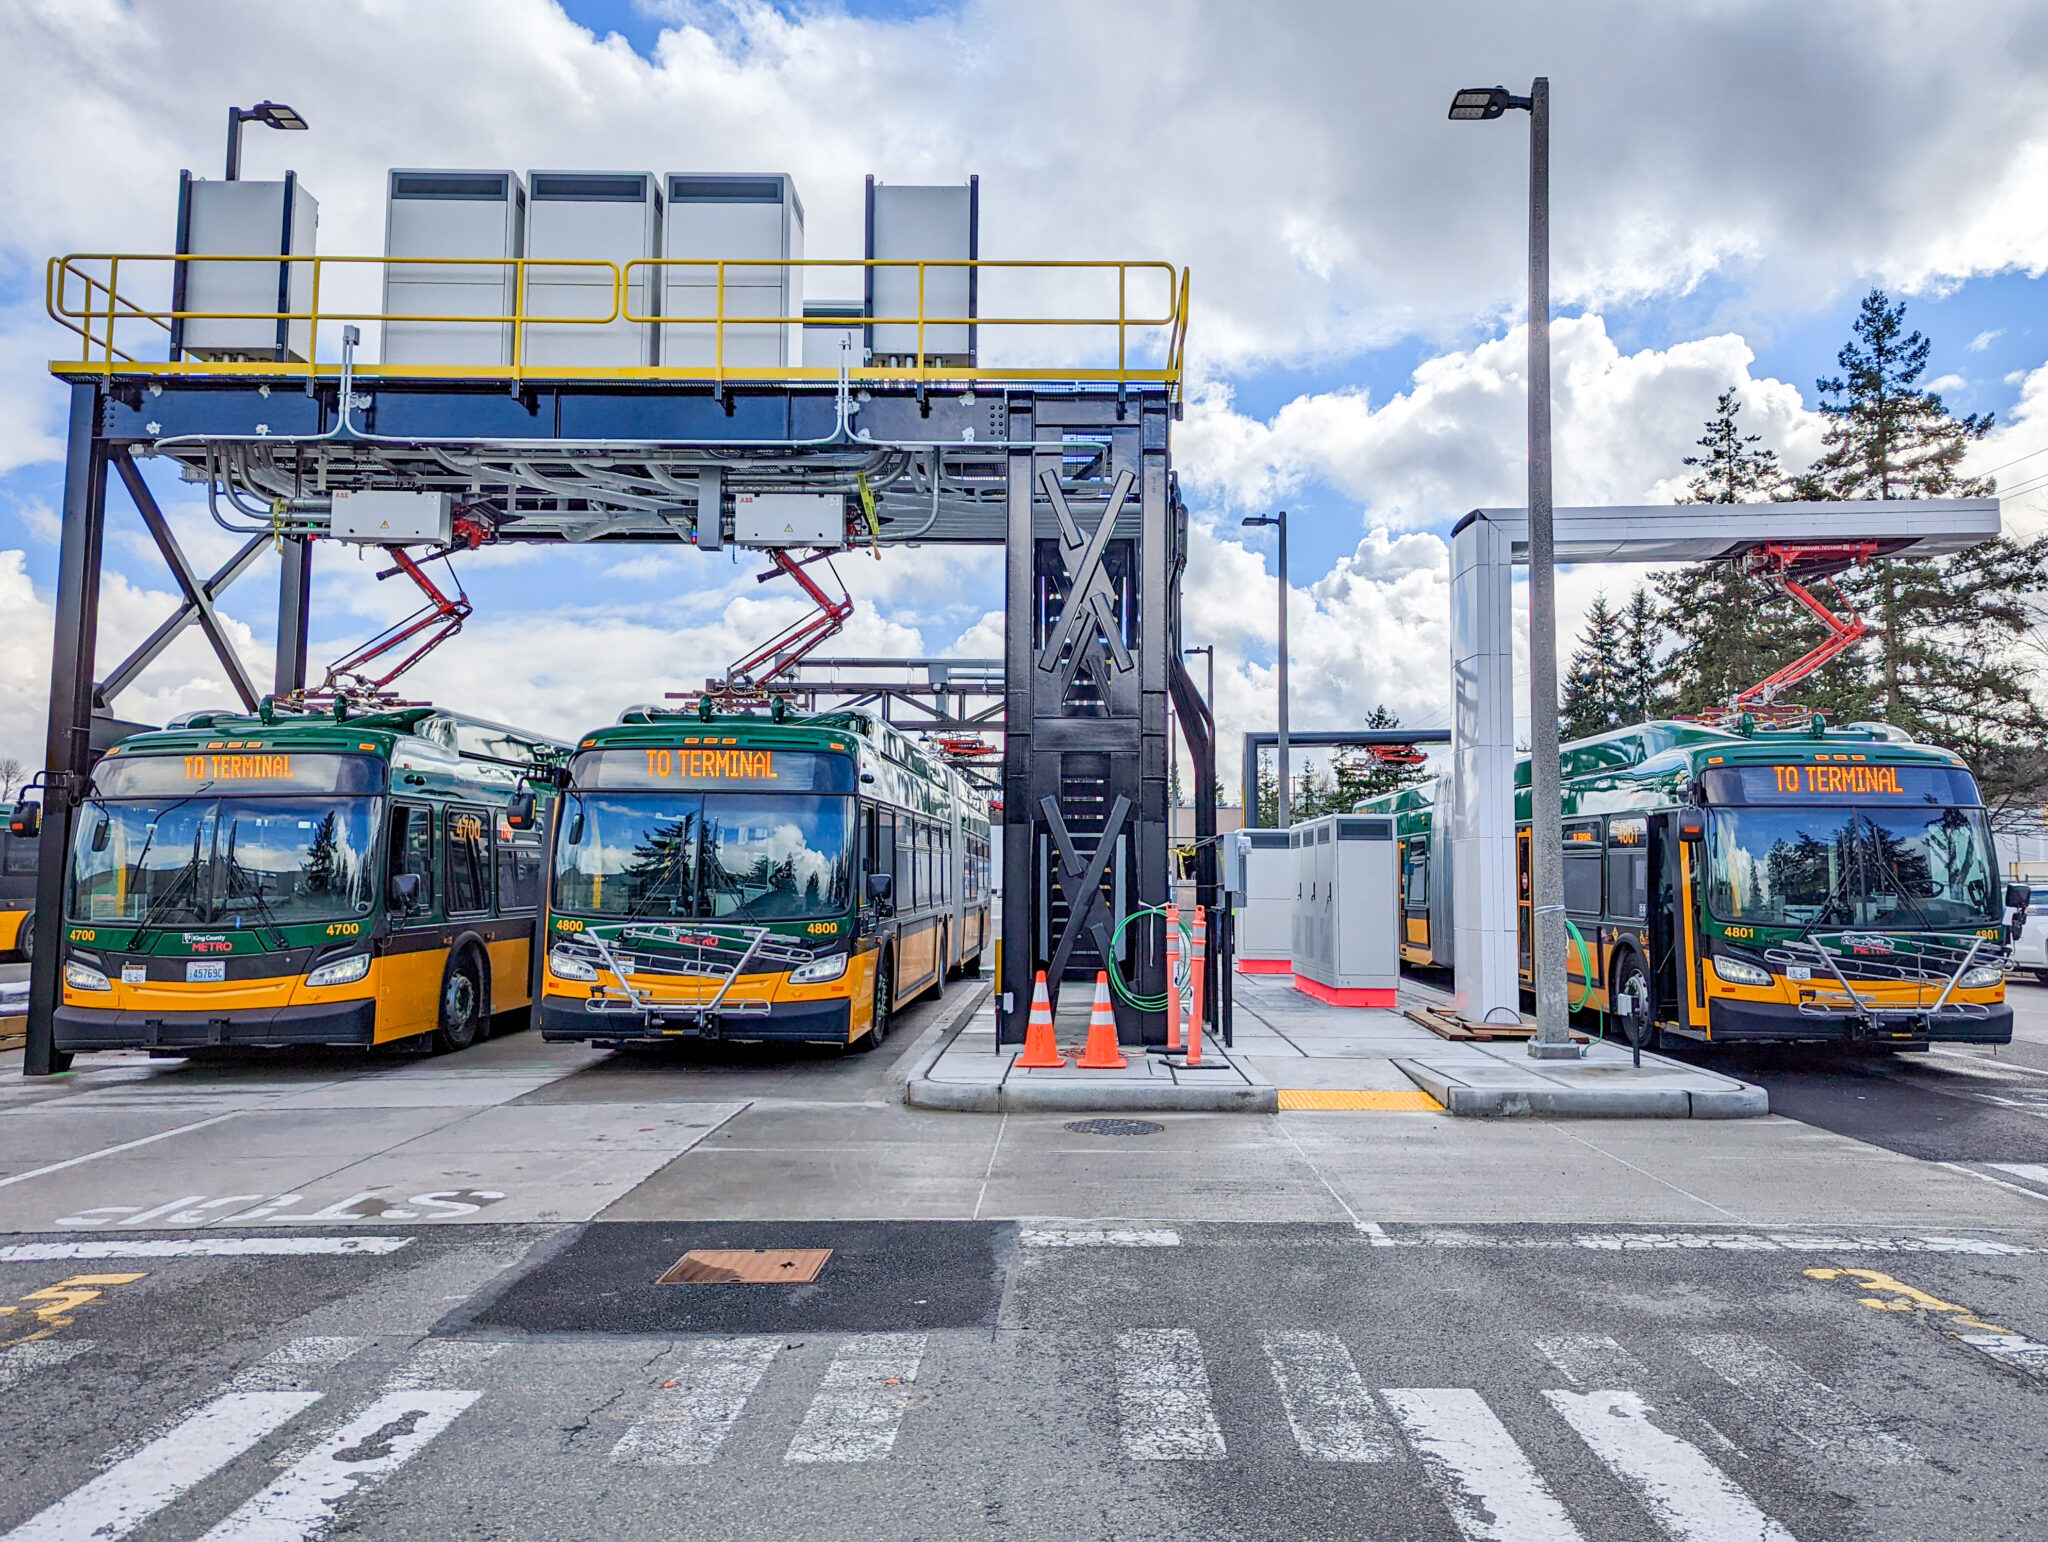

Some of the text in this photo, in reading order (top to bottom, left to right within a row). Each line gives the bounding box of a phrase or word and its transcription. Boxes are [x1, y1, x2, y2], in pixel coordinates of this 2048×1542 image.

[184, 754, 294, 779] TO TERMINAL
[646, 749, 778, 778] TO TERMINAL
[1773, 765, 1904, 793] TO TERMINAL
[456, 819, 481, 839] 4700
[1618, 825, 1638, 844] 4801
[326, 923, 359, 936] 4700
[556, 919, 583, 932] 4800
[807, 922, 838, 934] 4800
[70, 929, 95, 941] 4700
[1724, 927, 1754, 938] 4801
[192, 942, 233, 952] METRO
[678, 936, 720, 947] MERO
[54, 1191, 506, 1225] STOP
